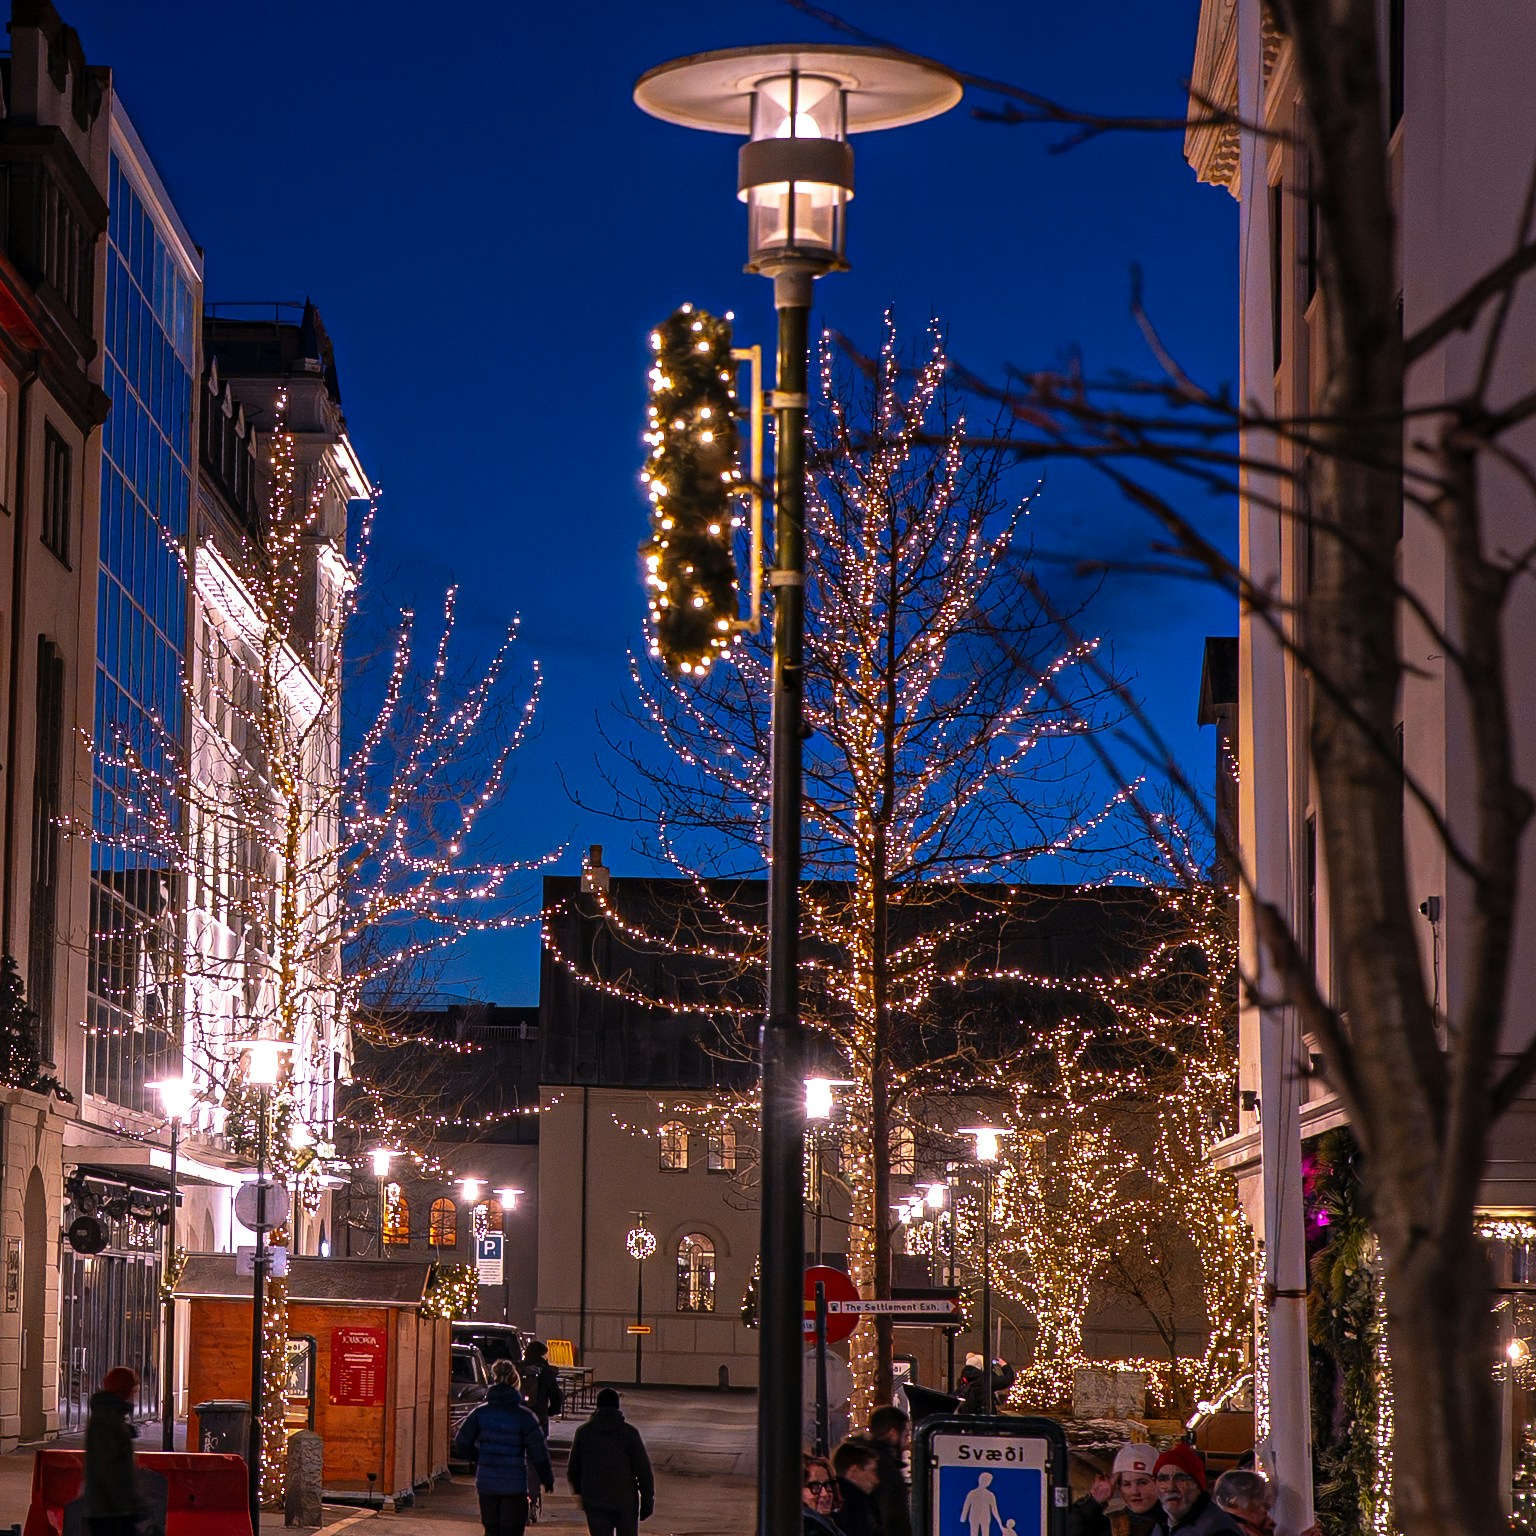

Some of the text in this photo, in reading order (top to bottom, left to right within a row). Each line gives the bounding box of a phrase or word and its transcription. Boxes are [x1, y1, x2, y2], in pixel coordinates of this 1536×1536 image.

[484, 1240, 496, 1256] P
[845, 1303, 940, 1312] The Settlement Exh.
[958, 1444, 1024, 1462] Svæði
